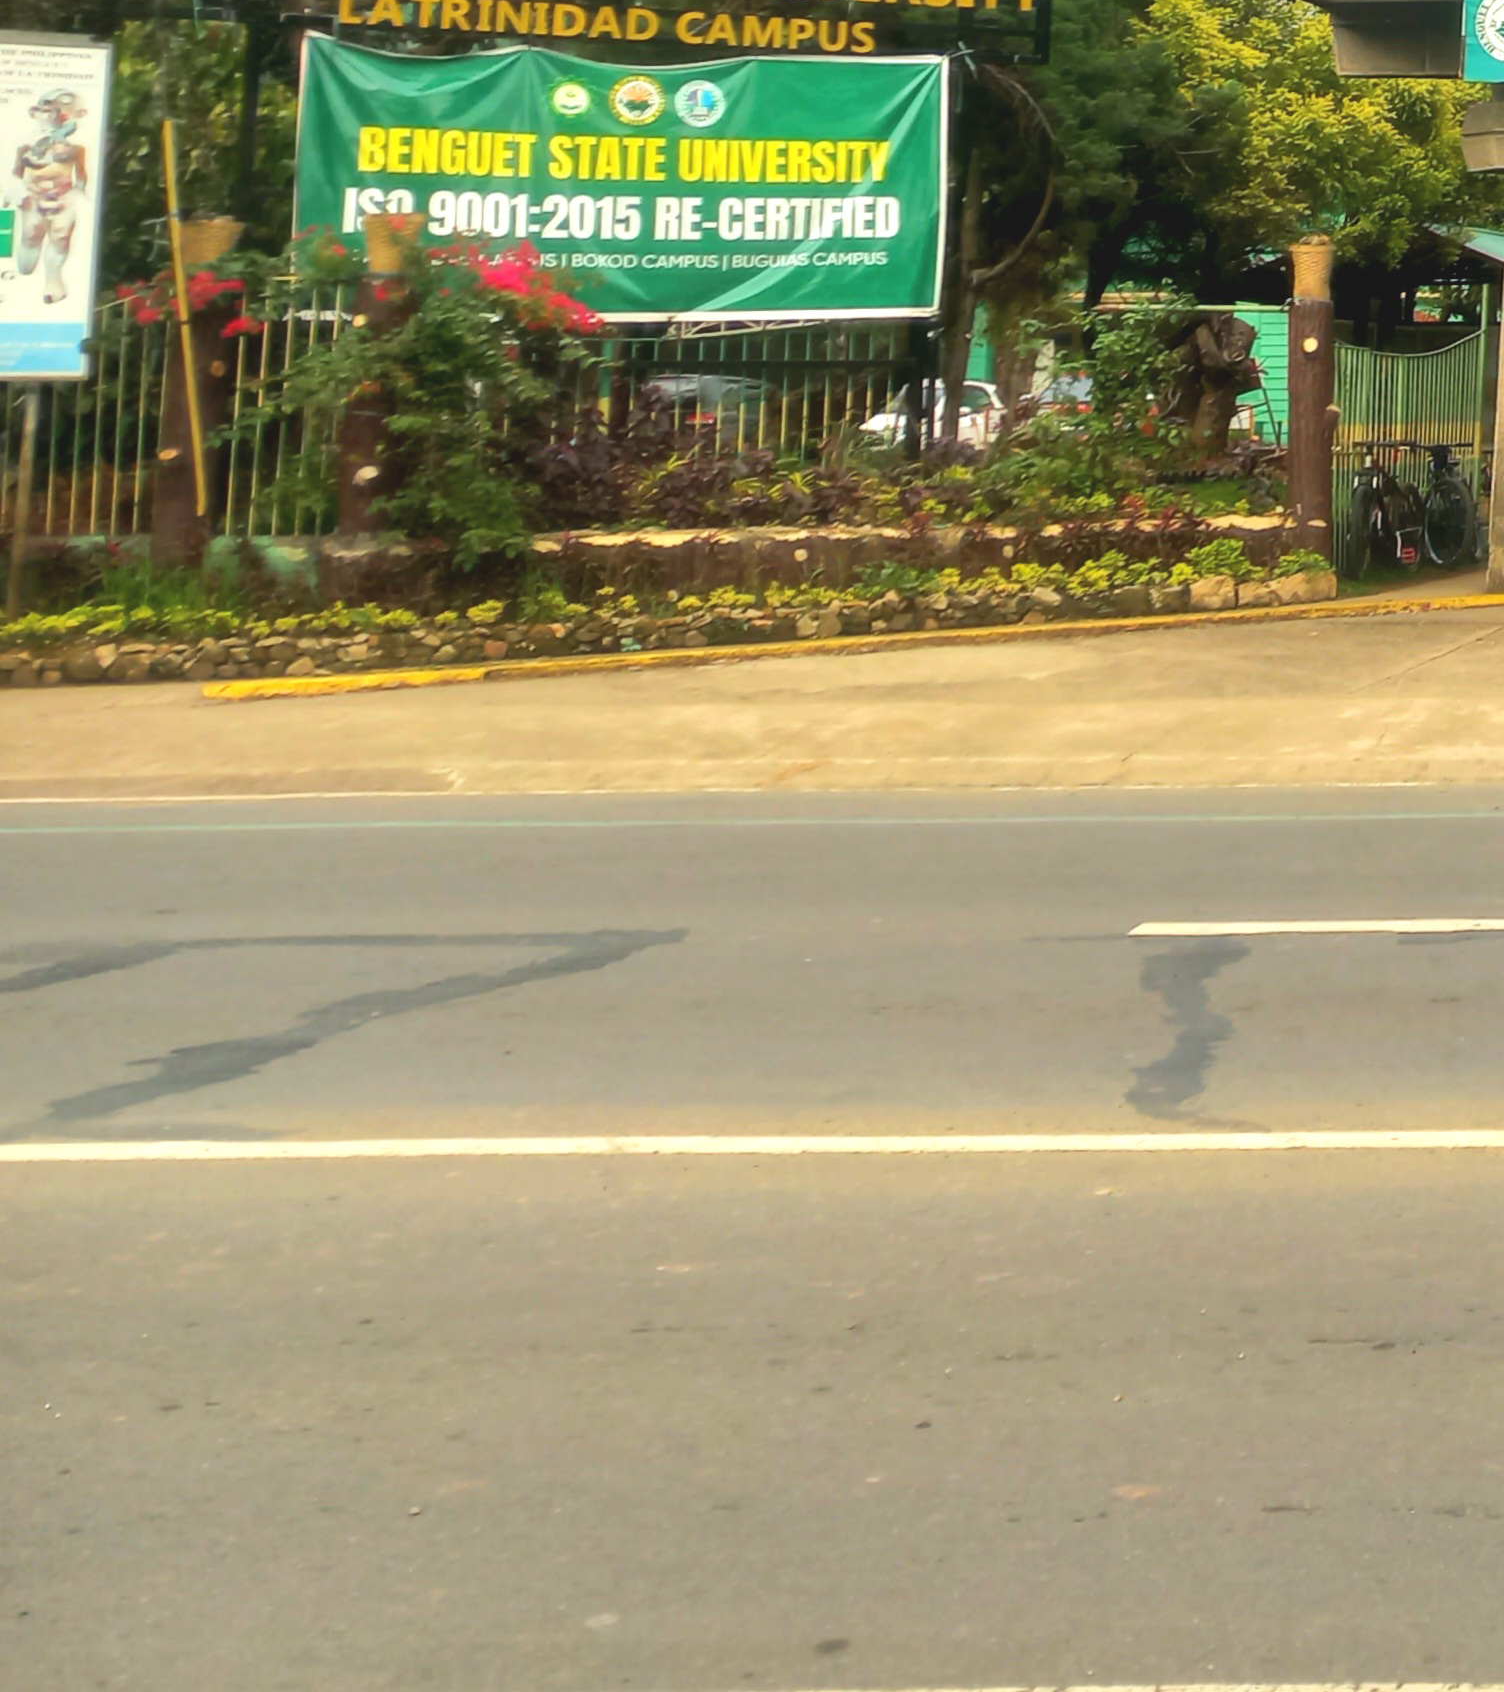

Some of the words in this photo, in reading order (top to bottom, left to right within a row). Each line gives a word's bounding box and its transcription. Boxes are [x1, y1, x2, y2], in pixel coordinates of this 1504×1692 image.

[675, 10, 876, 54] CAMPUS
[357, 125, 538, 178] BENGUET
[548, 134, 667, 182] STATE
[678, 138, 891, 184] UNIVERSITY
[427, 189, 643, 241] 9001:2015
[654, 195, 900, 241] RE-CERTIFIED
[571, 253, 638, 269] BOKOD
[641, 254, 718, 270] CAMPUS
[732, 254, 809, 269] BUGUIAS
[812, 251, 889, 267] CAMPUS
